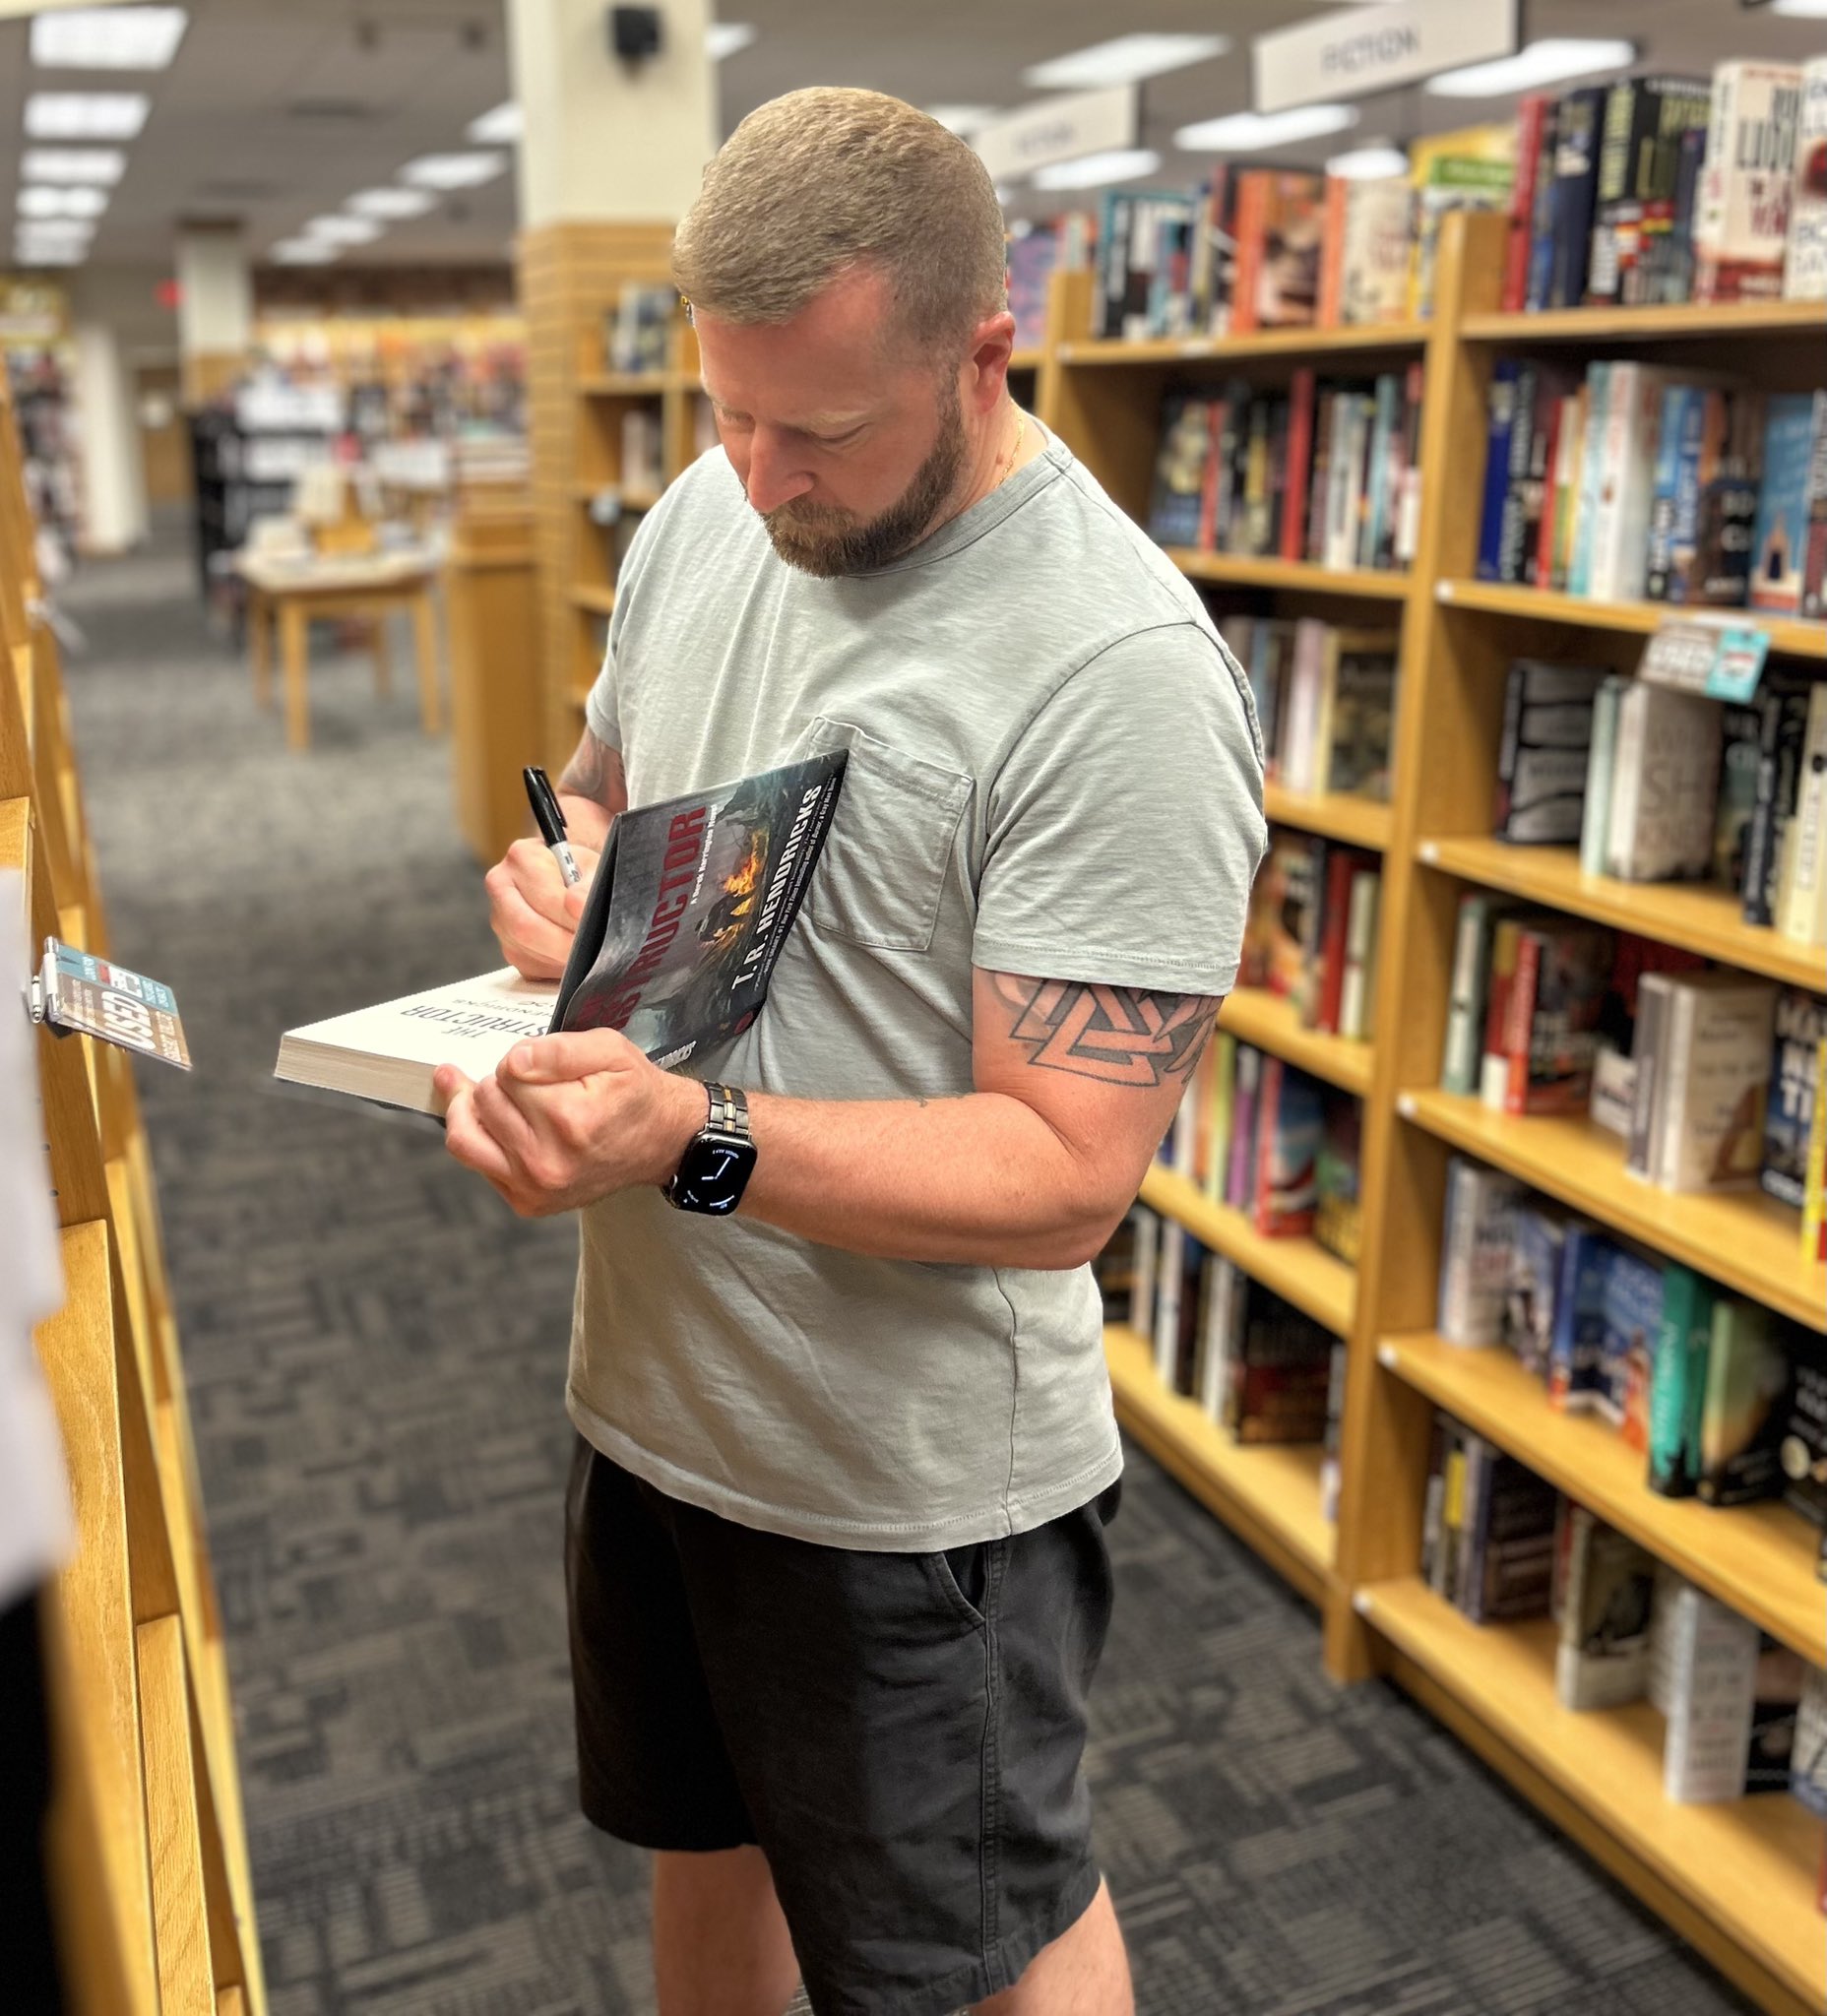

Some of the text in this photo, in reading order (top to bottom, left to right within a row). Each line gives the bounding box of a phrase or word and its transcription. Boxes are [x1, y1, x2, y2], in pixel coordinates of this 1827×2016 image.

[1322, 26, 1420, 75] FICTION
[707, 803, 718, 828] Novel
[698, 829, 714, 873] Harrington
[756, 785, 822, 934] HENDRICKS
[692, 872, 705, 898] Derek
[101, 991, 157, 1050] USED
[441, 1026, 488, 1039] THE
